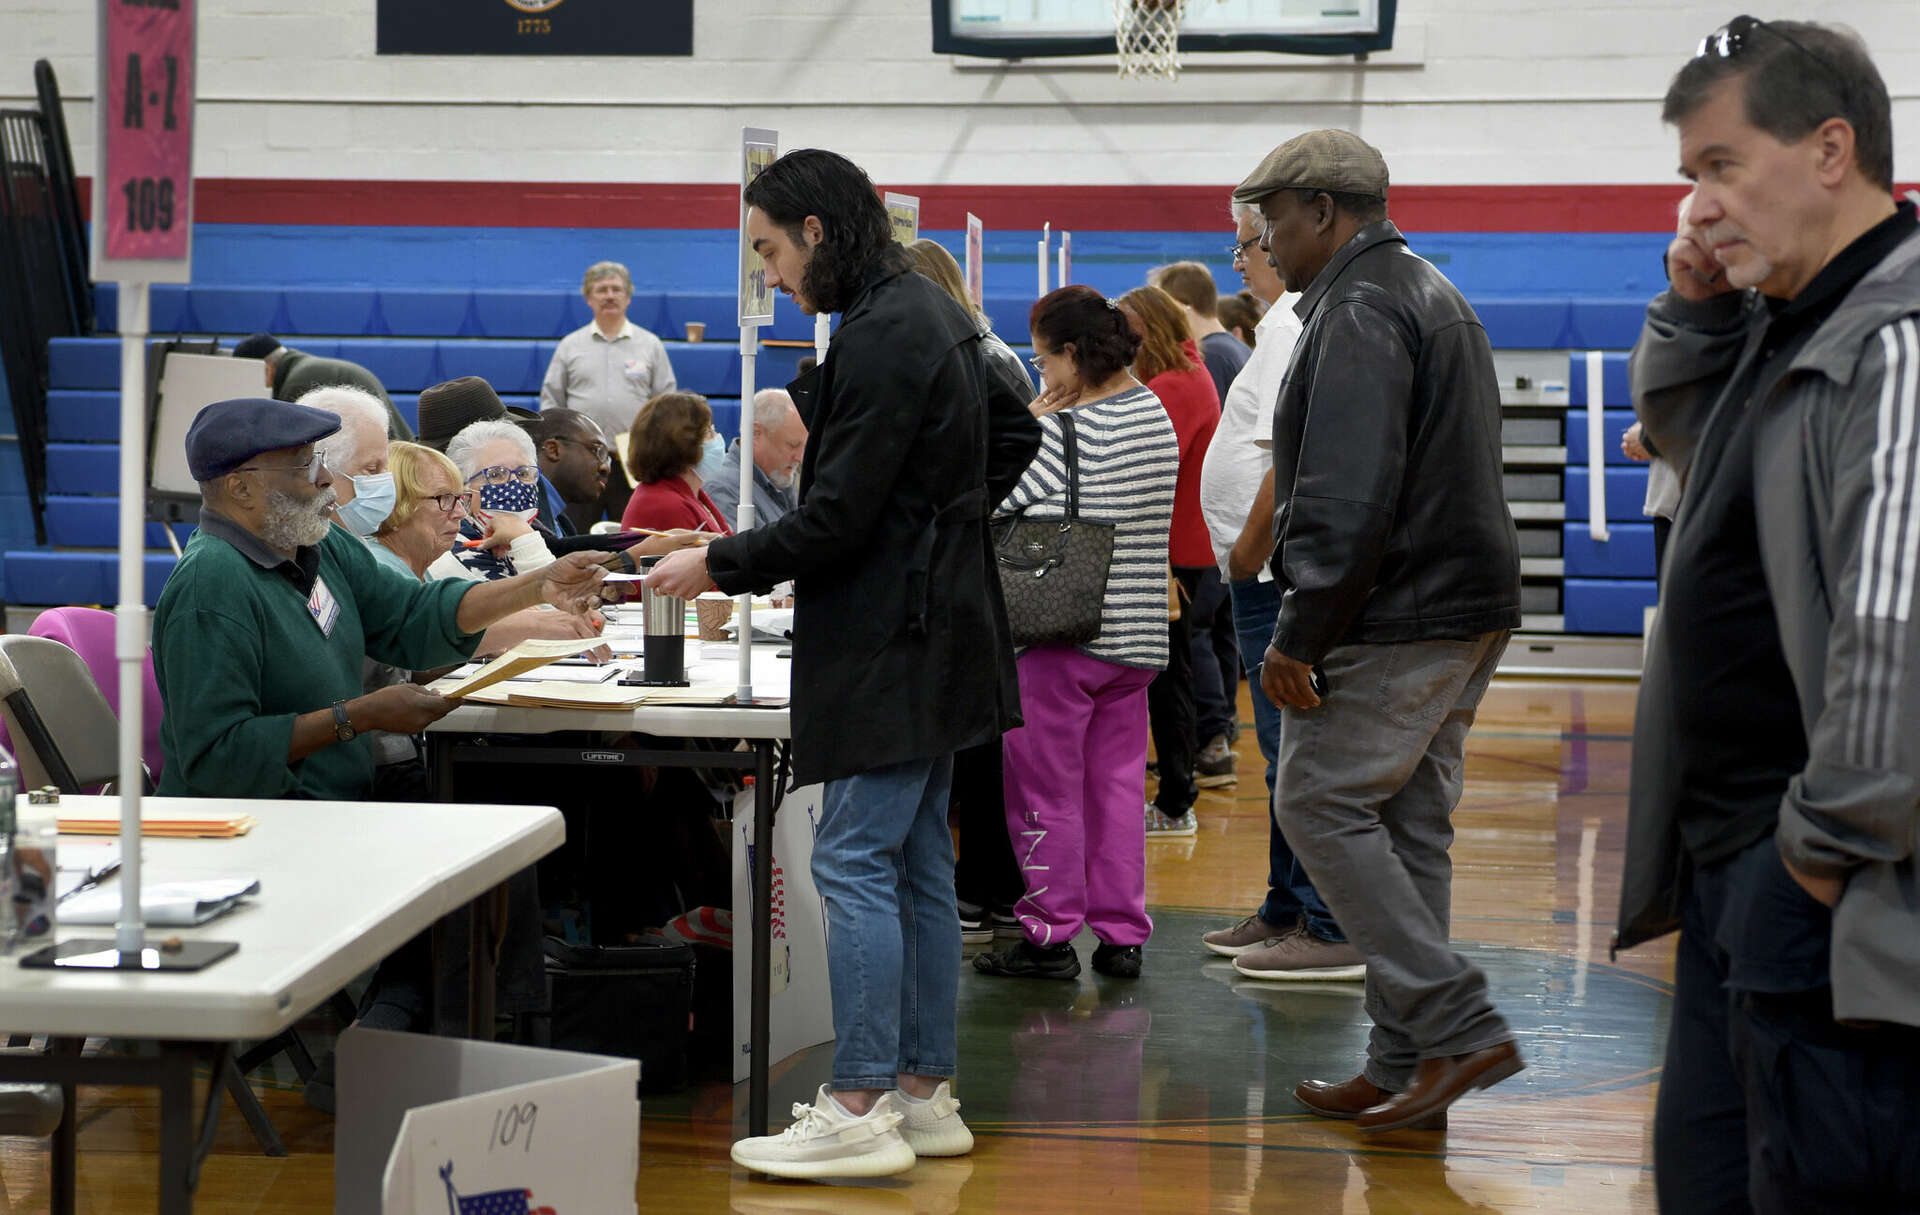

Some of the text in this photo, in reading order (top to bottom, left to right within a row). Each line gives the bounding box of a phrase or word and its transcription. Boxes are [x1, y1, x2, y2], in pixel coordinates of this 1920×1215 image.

[517, 19, 551, 34] 1775
[123, 177, 175, 232] 109
[488, 1101, 538, 1152] 109
